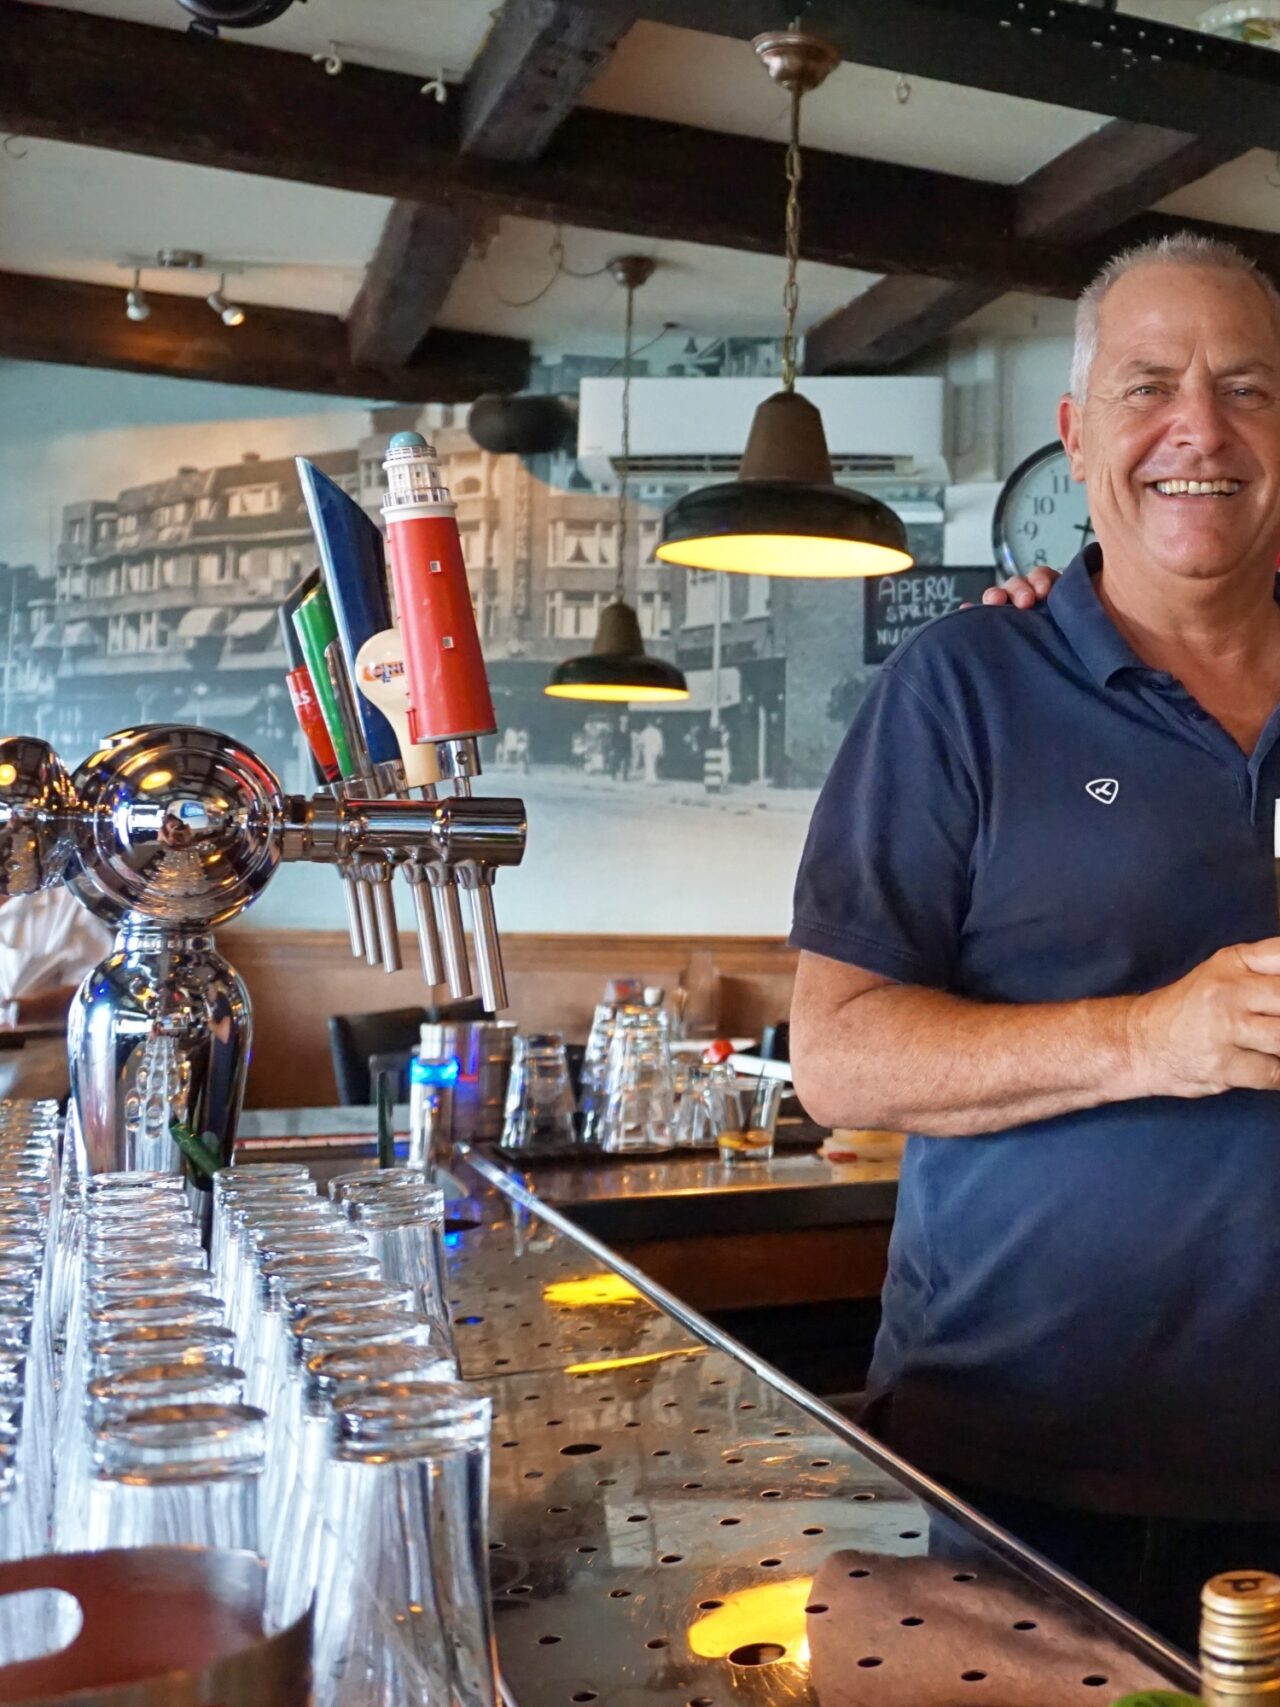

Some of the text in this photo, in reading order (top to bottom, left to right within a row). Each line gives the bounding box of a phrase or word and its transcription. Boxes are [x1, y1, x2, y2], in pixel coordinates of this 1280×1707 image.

[1053, 475, 1069, 494] 11
[1034, 496, 1055, 515] 10
[1023, 521, 1038, 540] 9
[878, 575, 962, 603] APEROL
